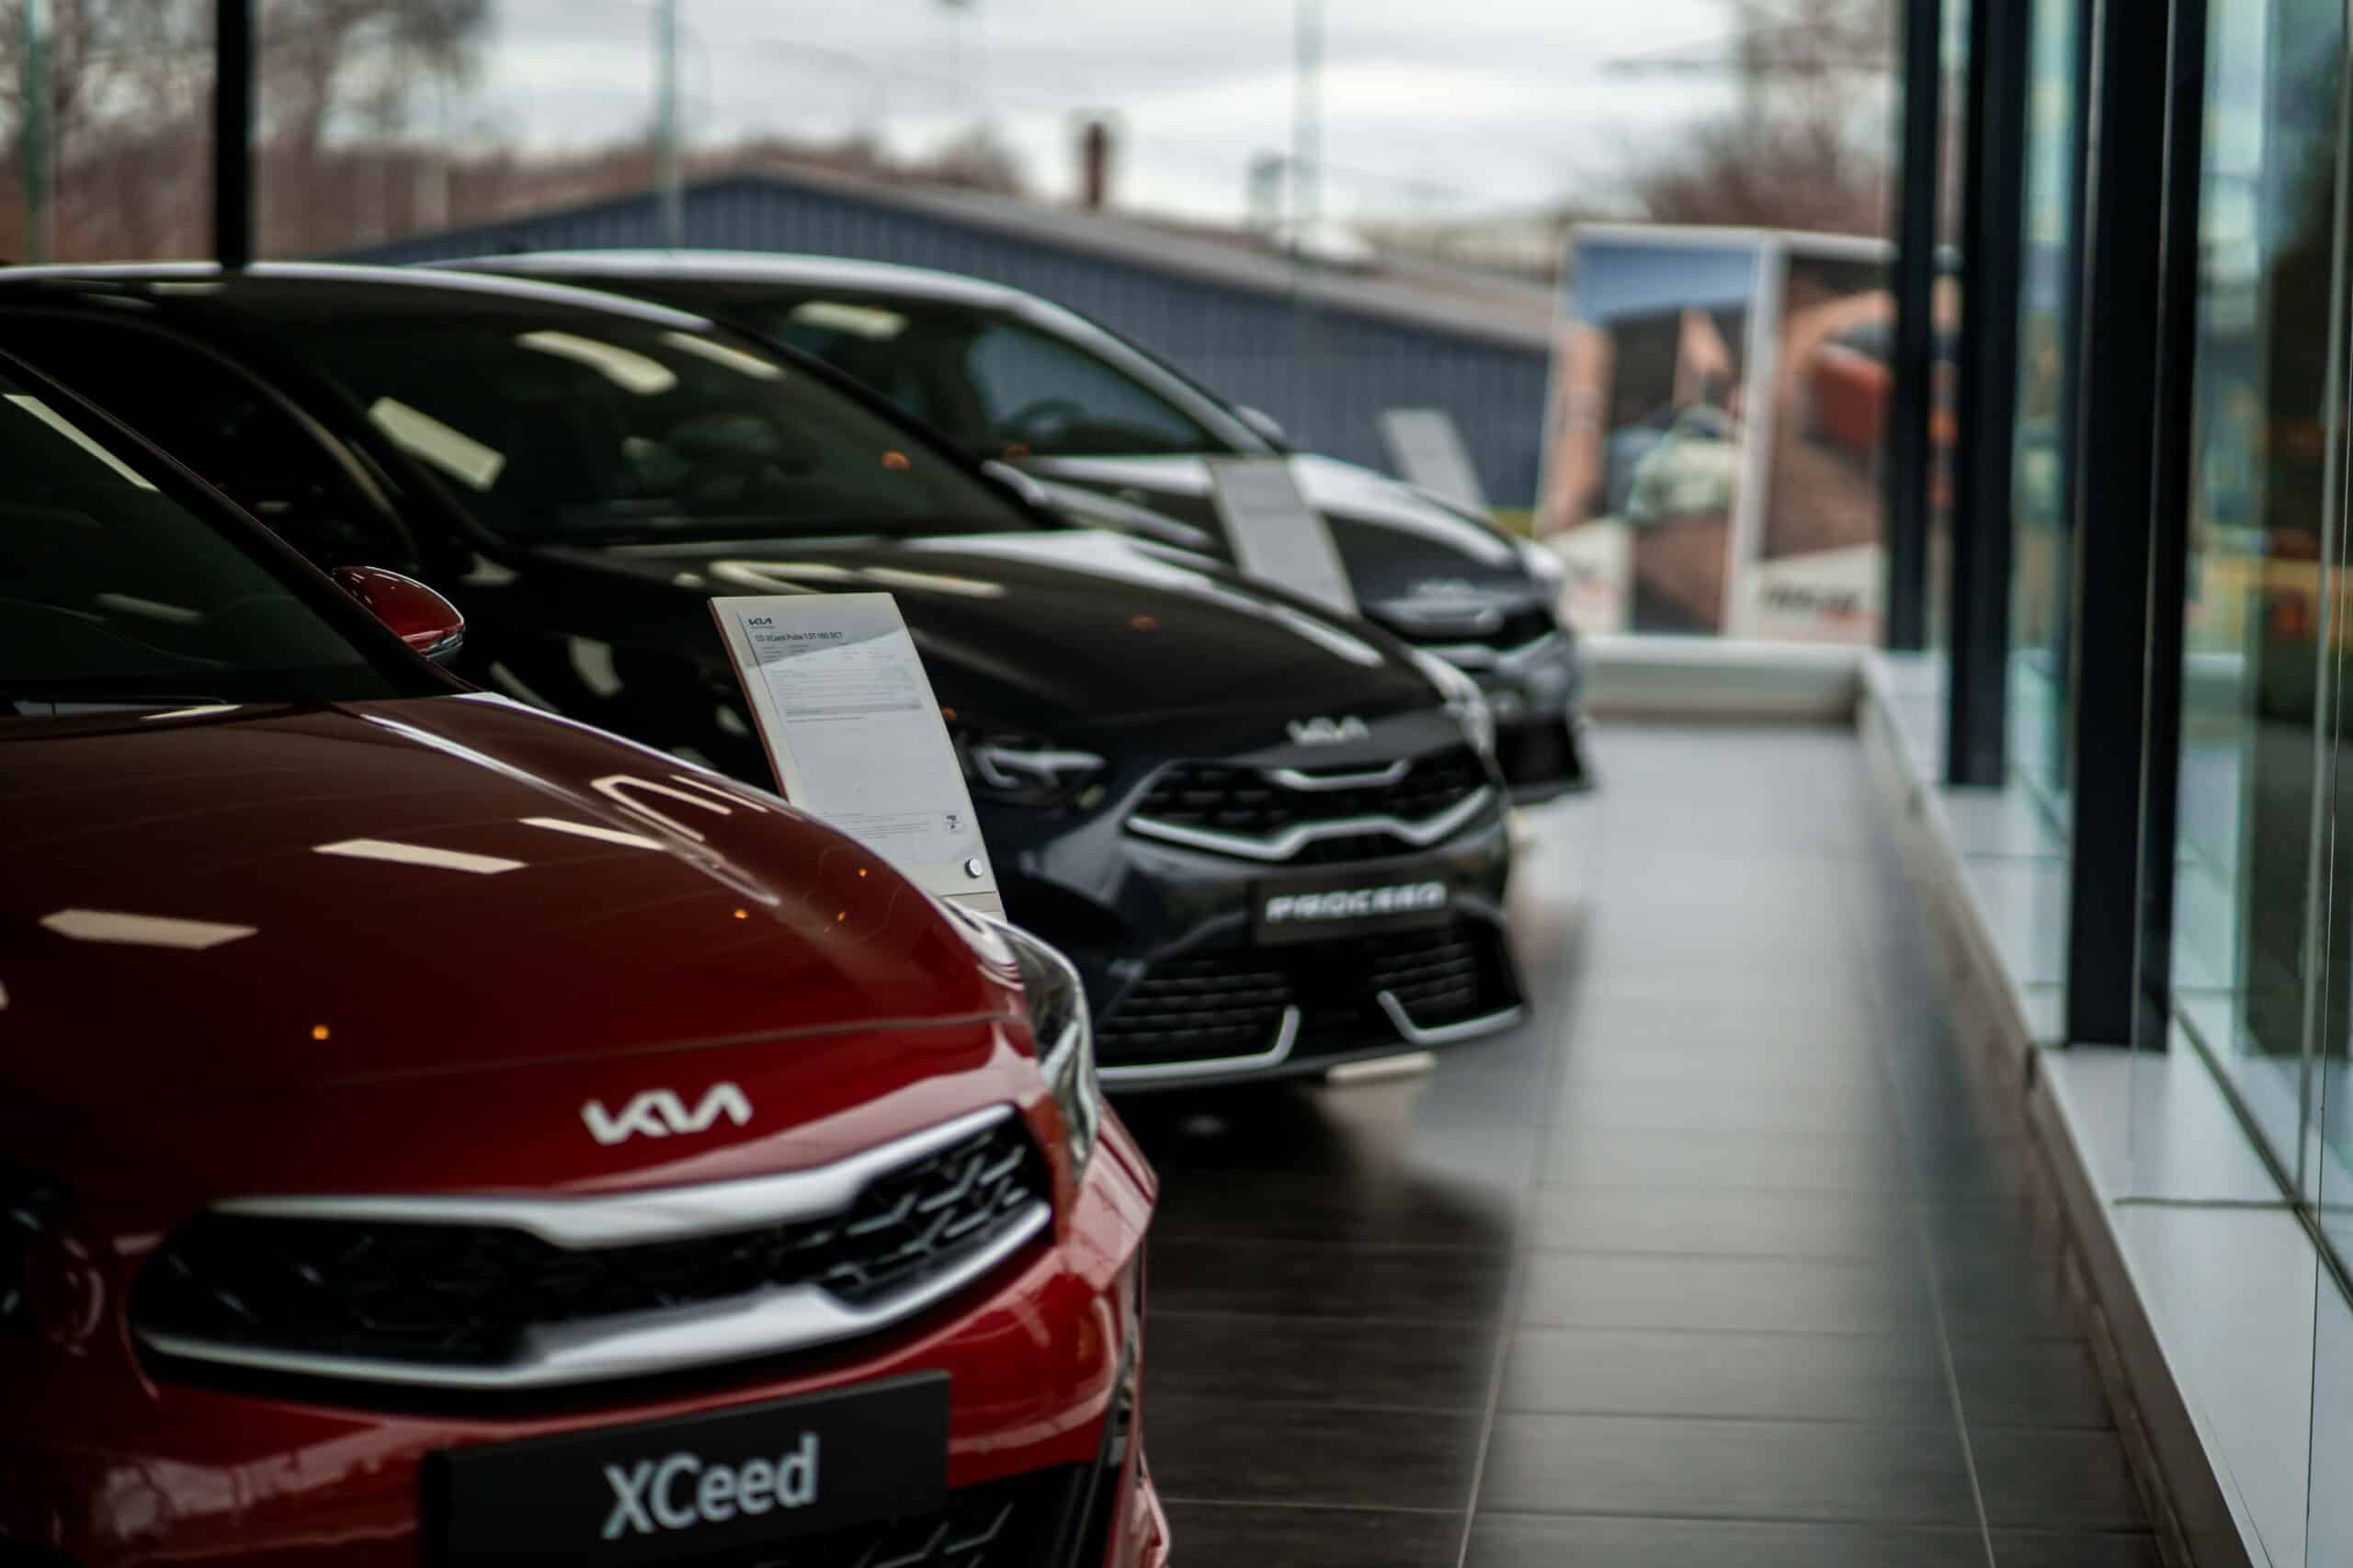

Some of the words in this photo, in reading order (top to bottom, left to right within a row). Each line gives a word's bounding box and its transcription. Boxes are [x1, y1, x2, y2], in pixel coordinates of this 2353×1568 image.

[748, 617, 772, 626] KIA
[1266, 881, 1448, 923] PROCEED
[581, 1082, 753, 1144] KIA
[603, 1430, 819, 1540] XCeed
